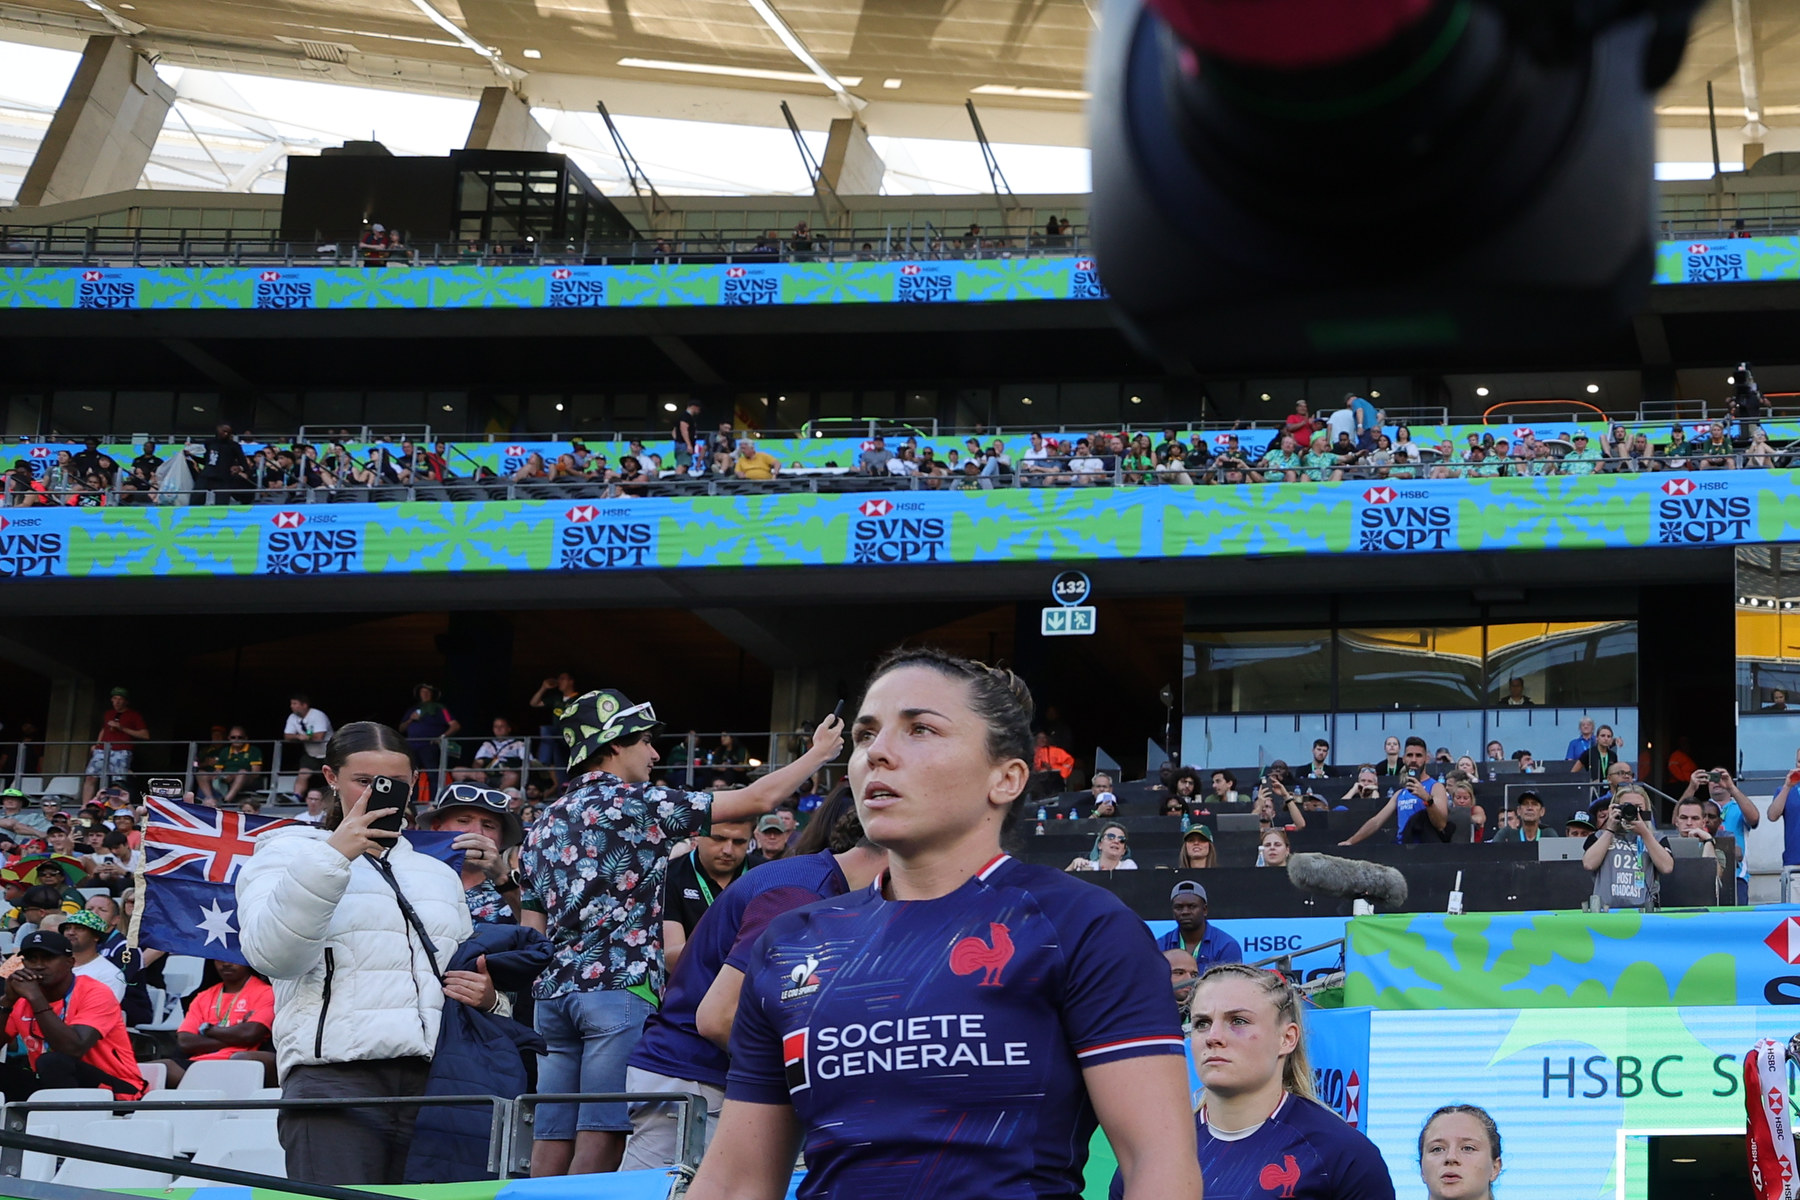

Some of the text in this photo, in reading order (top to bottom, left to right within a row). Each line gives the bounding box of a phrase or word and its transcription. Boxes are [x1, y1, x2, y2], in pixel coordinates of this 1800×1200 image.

[1688, 254, 1741, 268] SVNS
[1704, 267, 1742, 281] CPT
[80, 283, 134, 295] SVNS
[257, 283, 311, 295] SVNS
[551, 281, 603, 294] SVNS
[724, 279, 777, 292] SVNS
[899, 276, 952, 288] SVNS
[566, 294, 603, 307] CPT
[740, 292, 777, 304] CPT
[914, 288, 952, 301] CPT
[95, 296, 134, 309] CPT
[273, 296, 311, 309] CPT
[1700, 481, 1728, 491] HSBC
[1401, 490, 1429, 499] HSBC
[603, 508, 631, 516] HSBC
[897, 502, 925, 511] HSBC
[1660, 497, 1750, 520] SVNS
[13, 518, 42, 527] HSBC
[309, 514, 338, 523] HSBC
[1361, 506, 1450, 528] SVNS
[561, 524, 651, 547] SVNS
[855, 518, 944, 541] SVNS
[1683, 519, 1751, 542] CPT
[0, 533, 61, 553] VNS
[268, 529, 357, 554] SVNS
[1384, 528, 1451, 551] CPT
[585, 545, 651, 568] CPT
[878, 540, 944, 563] CPT
[0, 557, 59, 577] CPT
[292, 552, 356, 575] CPT
[1057, 581, 1086, 594] 132
[1613, 854, 1641, 869] 022
[1616, 872, 1633, 884] HOST
[1244, 935, 1303, 952] HSBC
[817, 1014, 987, 1051] SOCIETE
[817, 1042, 1031, 1079] GENERALE
[1767, 1048, 1776, 1073] HSBC
[1542, 1055, 1684, 1098] HSBC
[1775, 1116, 1785, 1141] HSBC
